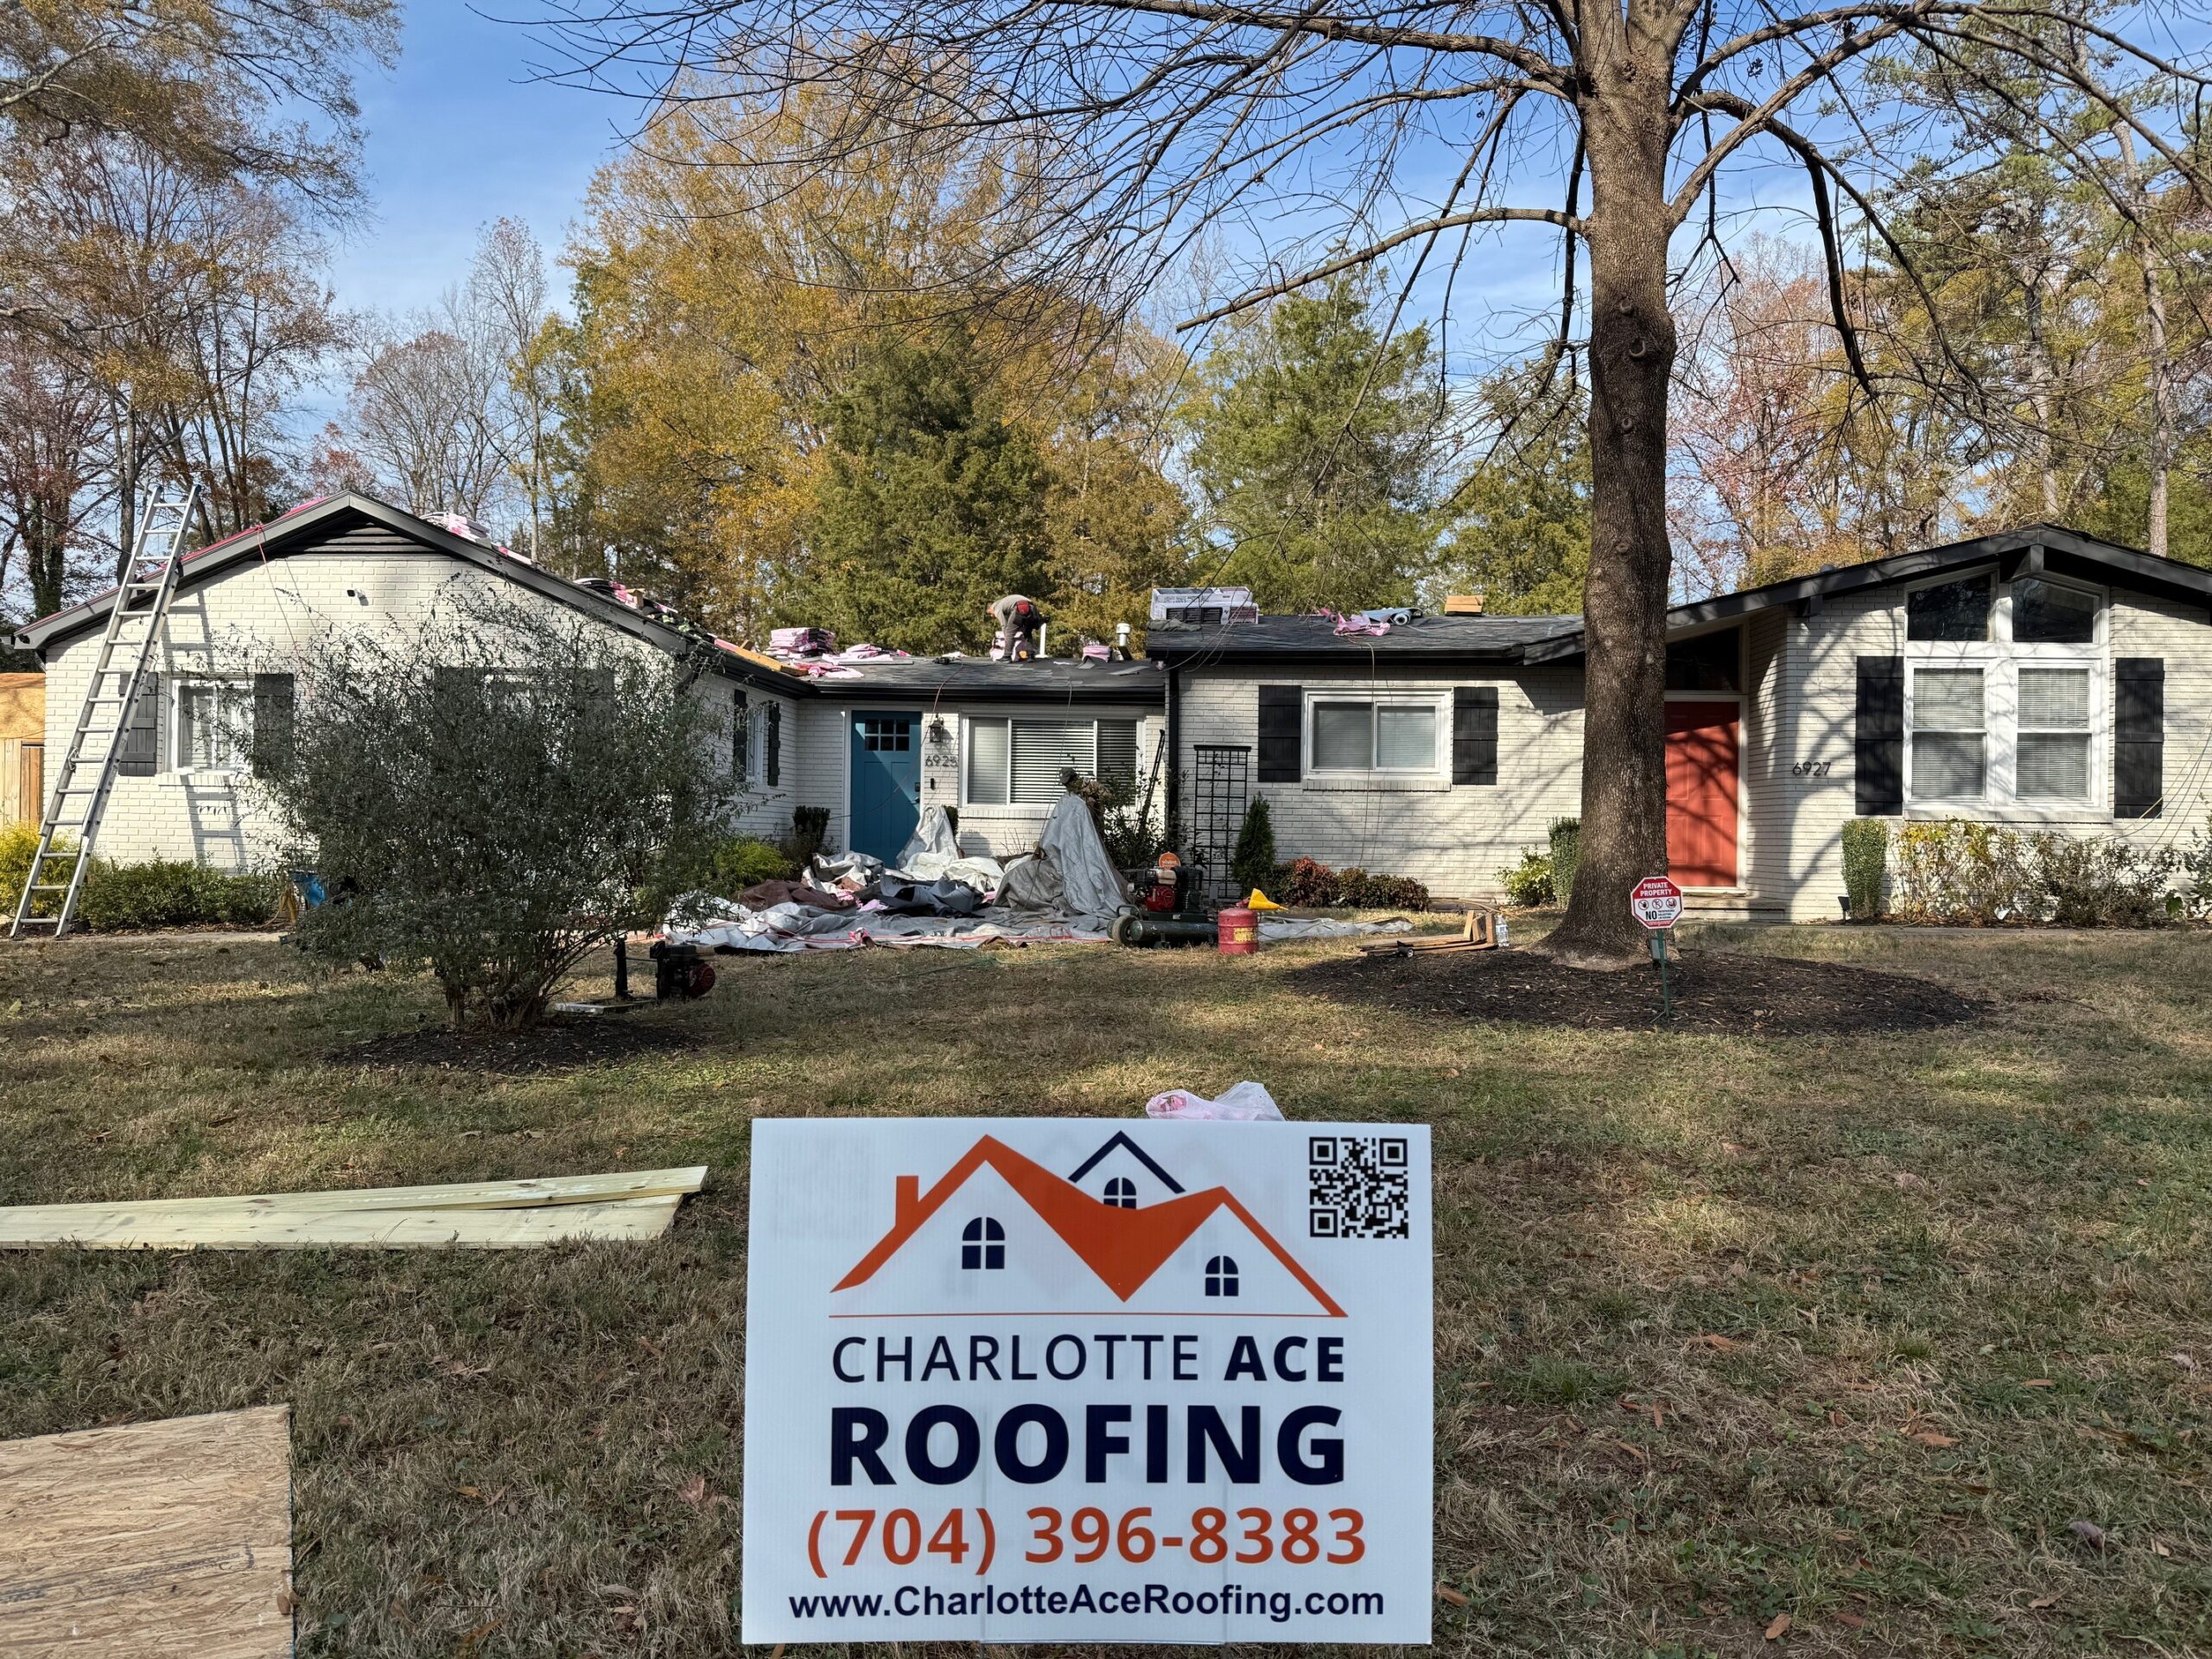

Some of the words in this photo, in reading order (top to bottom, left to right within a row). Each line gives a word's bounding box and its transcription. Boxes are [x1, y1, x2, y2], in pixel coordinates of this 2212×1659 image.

[1792, 761, 1831, 776] 6927
[1645, 911, 1657, 919] NO
[832, 1334, 1198, 1382] CHARLOTTE
[1224, 1335, 1344, 1382] ACE
[830, 1403, 1344, 1486] ROOFING
[808, 1509, 995, 1579] (704)
[1026, 1507, 1365, 1565] 396-8383
[788, 1584, 1384, 1623] www.CharlotteAceRoofing.com
